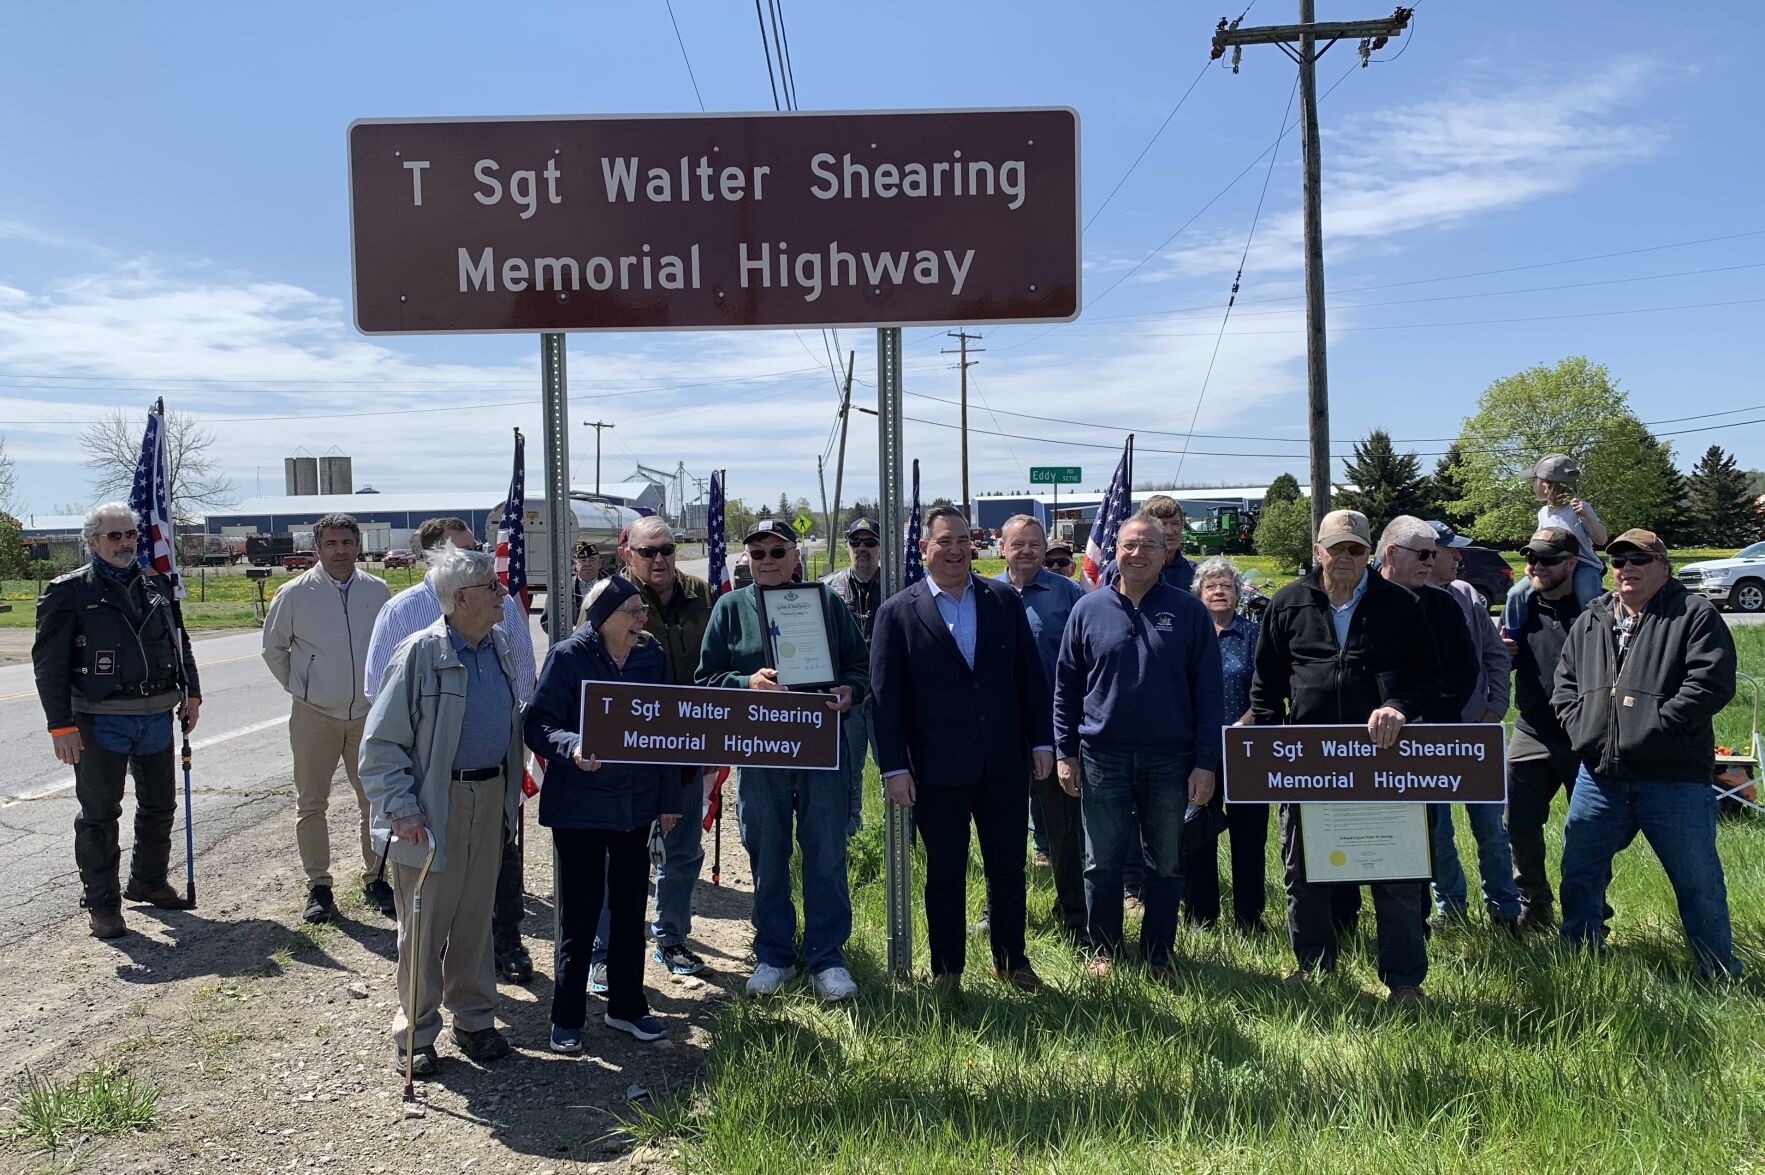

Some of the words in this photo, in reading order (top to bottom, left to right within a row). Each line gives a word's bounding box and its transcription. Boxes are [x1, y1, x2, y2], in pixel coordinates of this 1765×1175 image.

[403, 160, 430, 206] T
[473, 158, 562, 220] Sgt
[600, 156, 770, 203] Walter
[810, 150, 1026, 210] Shearing
[457, 244, 701, 293] Memorial
[739, 241, 976, 303] Highway
[1032, 470, 1057, 483] Eddy
[602, 697, 613, 715] T
[630, 699, 661, 722] Sgt
[678, 701, 731, 720] Walter
[748, 704, 823, 729] Shearing
[623, 731, 706, 751] Memorial
[724, 735, 802, 758] Highway
[1242, 741, 1254, 758] T
[1272, 740, 1304, 763] Sgt
[1321, 740, 1378, 757] Walter
[1399, 739, 1486, 762] Shearing
[1267, 771, 1354, 789] Memorial
[1374, 771, 1462, 794] Highway
